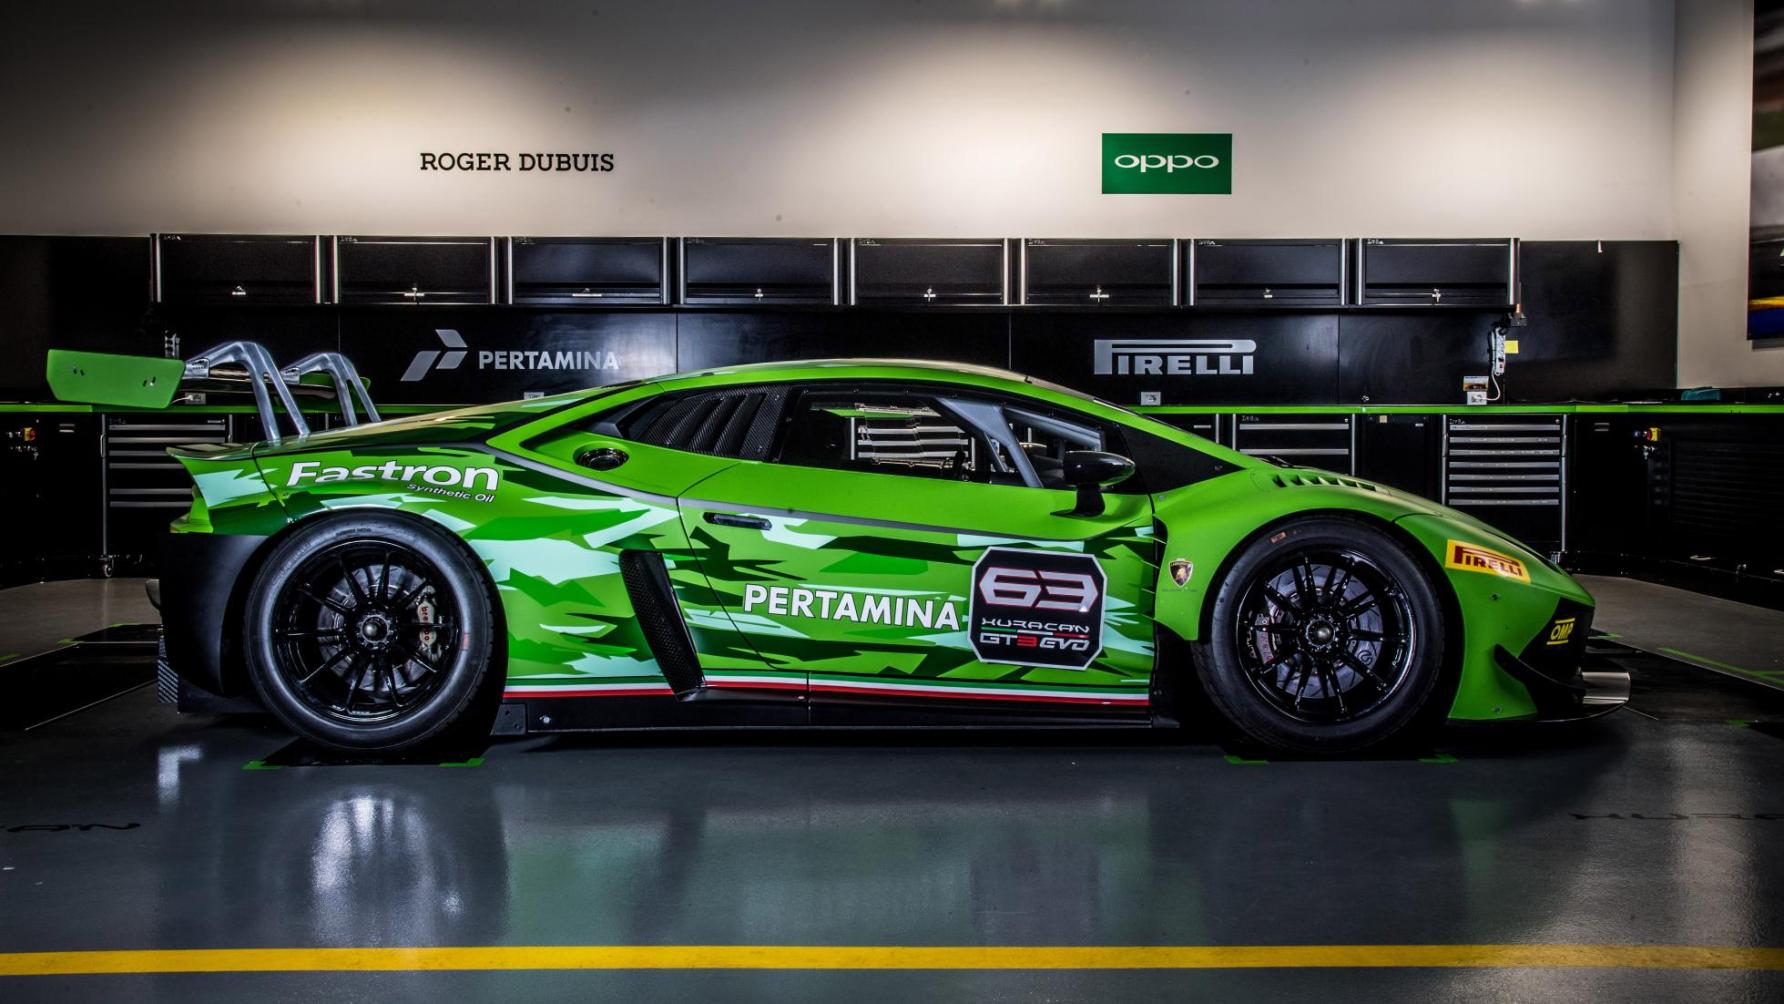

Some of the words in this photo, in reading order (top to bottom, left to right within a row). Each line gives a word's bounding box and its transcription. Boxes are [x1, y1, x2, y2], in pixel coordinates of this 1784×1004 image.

[420, 153, 511, 171] ROGER
[519, 153, 614, 172] DUBUIS
[1114, 154, 1220, 173] oppo
[478, 351, 620, 370] PERTAMINA
[1094, 339, 1257, 375] PIRELLI
[286, 459, 499, 490] Fastron
[407, 483, 471, 499] Synthetic
[474, 493, 495, 503] Oil
[1454, 545, 1523, 577] PIRELLI
[979, 567, 1098, 612] 63
[743, 584, 960, 631] PERTAMINA
[1551, 623, 1574, 640] OMP
